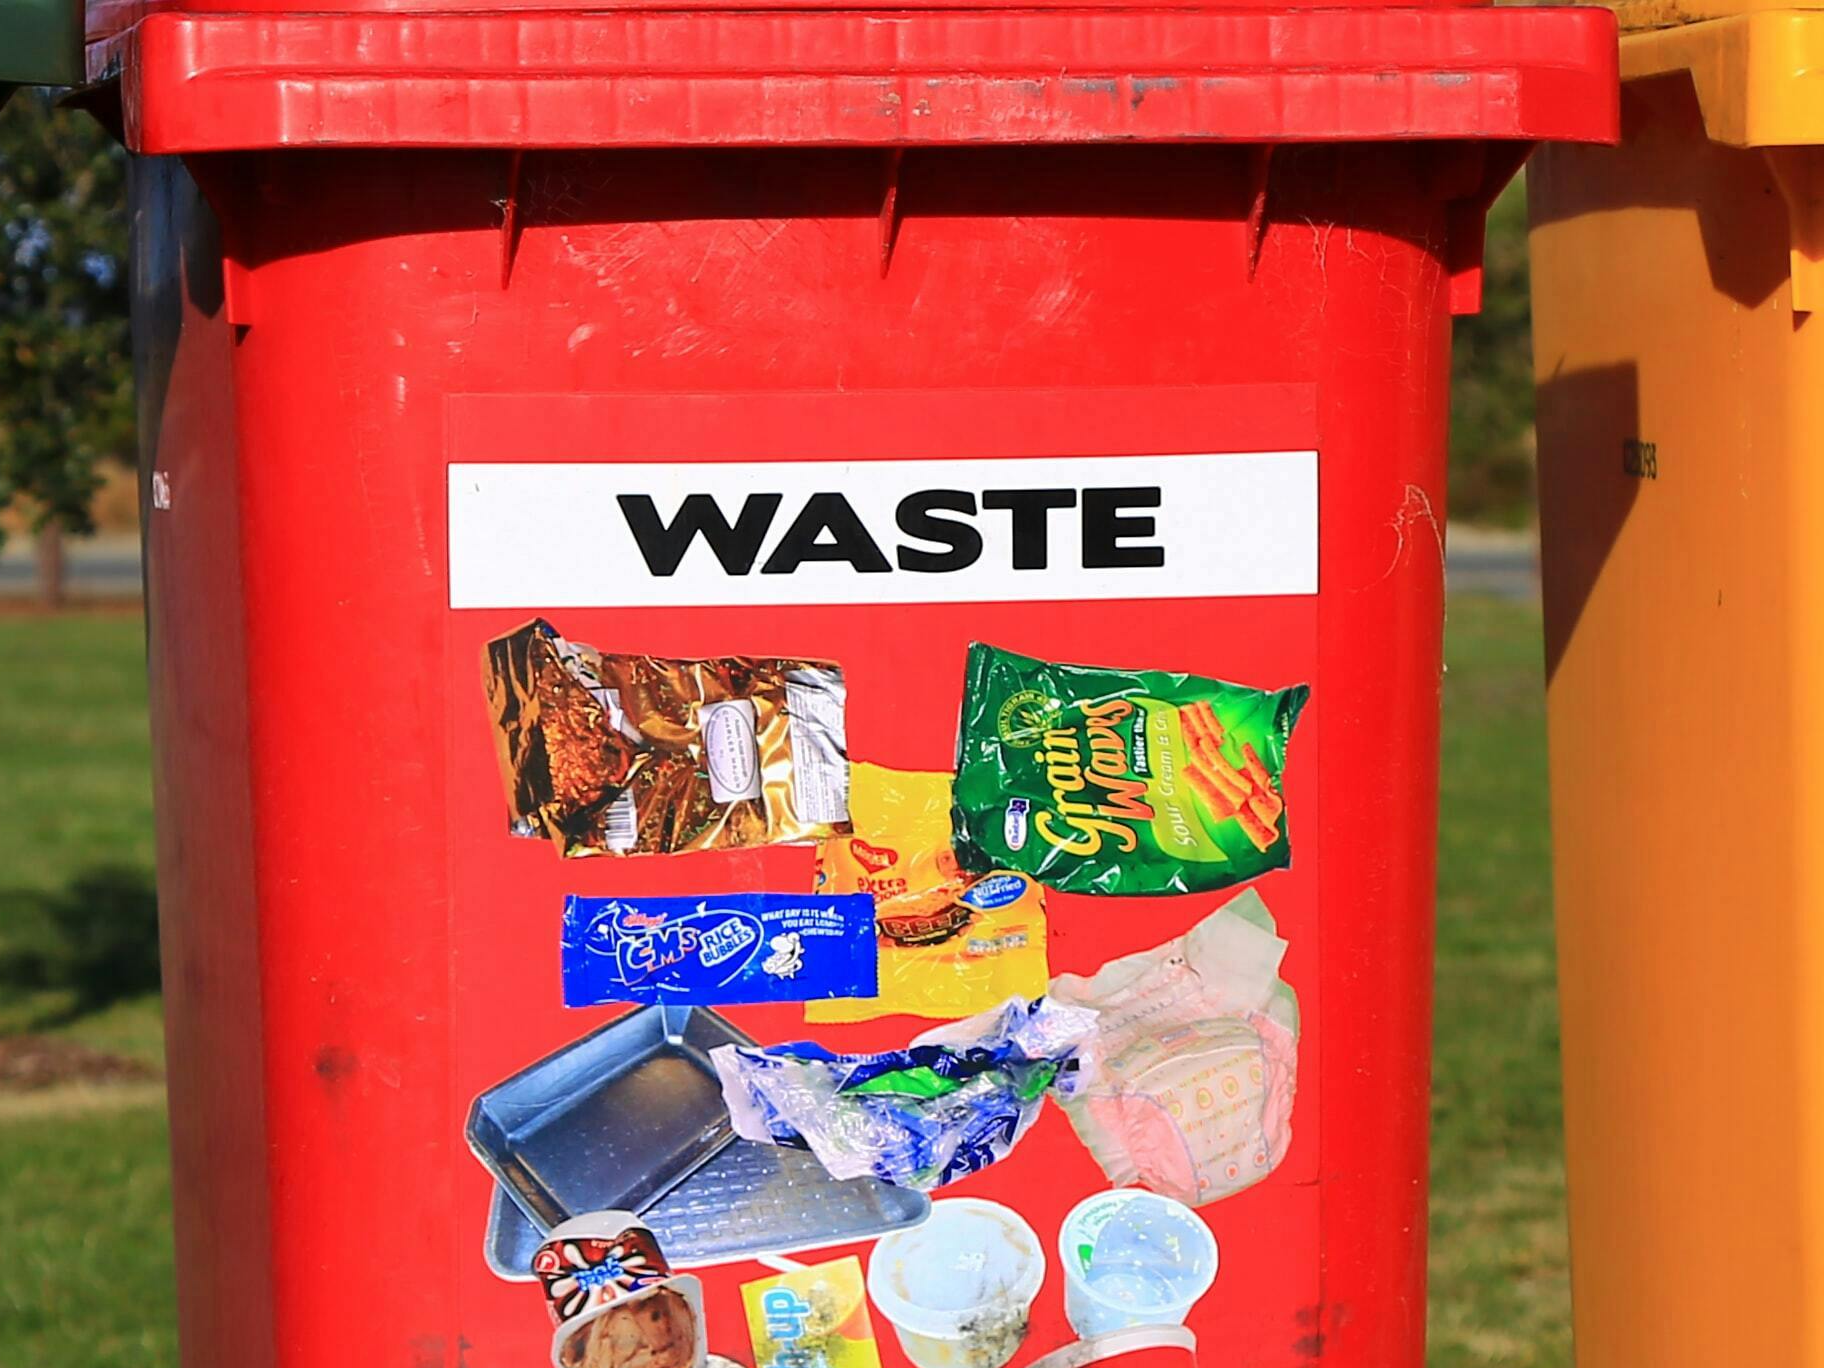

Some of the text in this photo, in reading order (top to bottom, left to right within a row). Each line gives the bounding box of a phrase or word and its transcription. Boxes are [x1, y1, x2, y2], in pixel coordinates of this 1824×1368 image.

[616, 486, 1165, 577] WASTE
[1079, 698, 1156, 821] Waves
[1158, 750, 1175, 797] Cream
[1034, 726, 1139, 856] Grain
[1166, 801, 1198, 848] Sour
[857, 876, 907, 896] extra
[703, 930, 753, 963] BUBBLES
[705, 919, 744, 950] RICE
[798, 918, 814, 928] EAT
